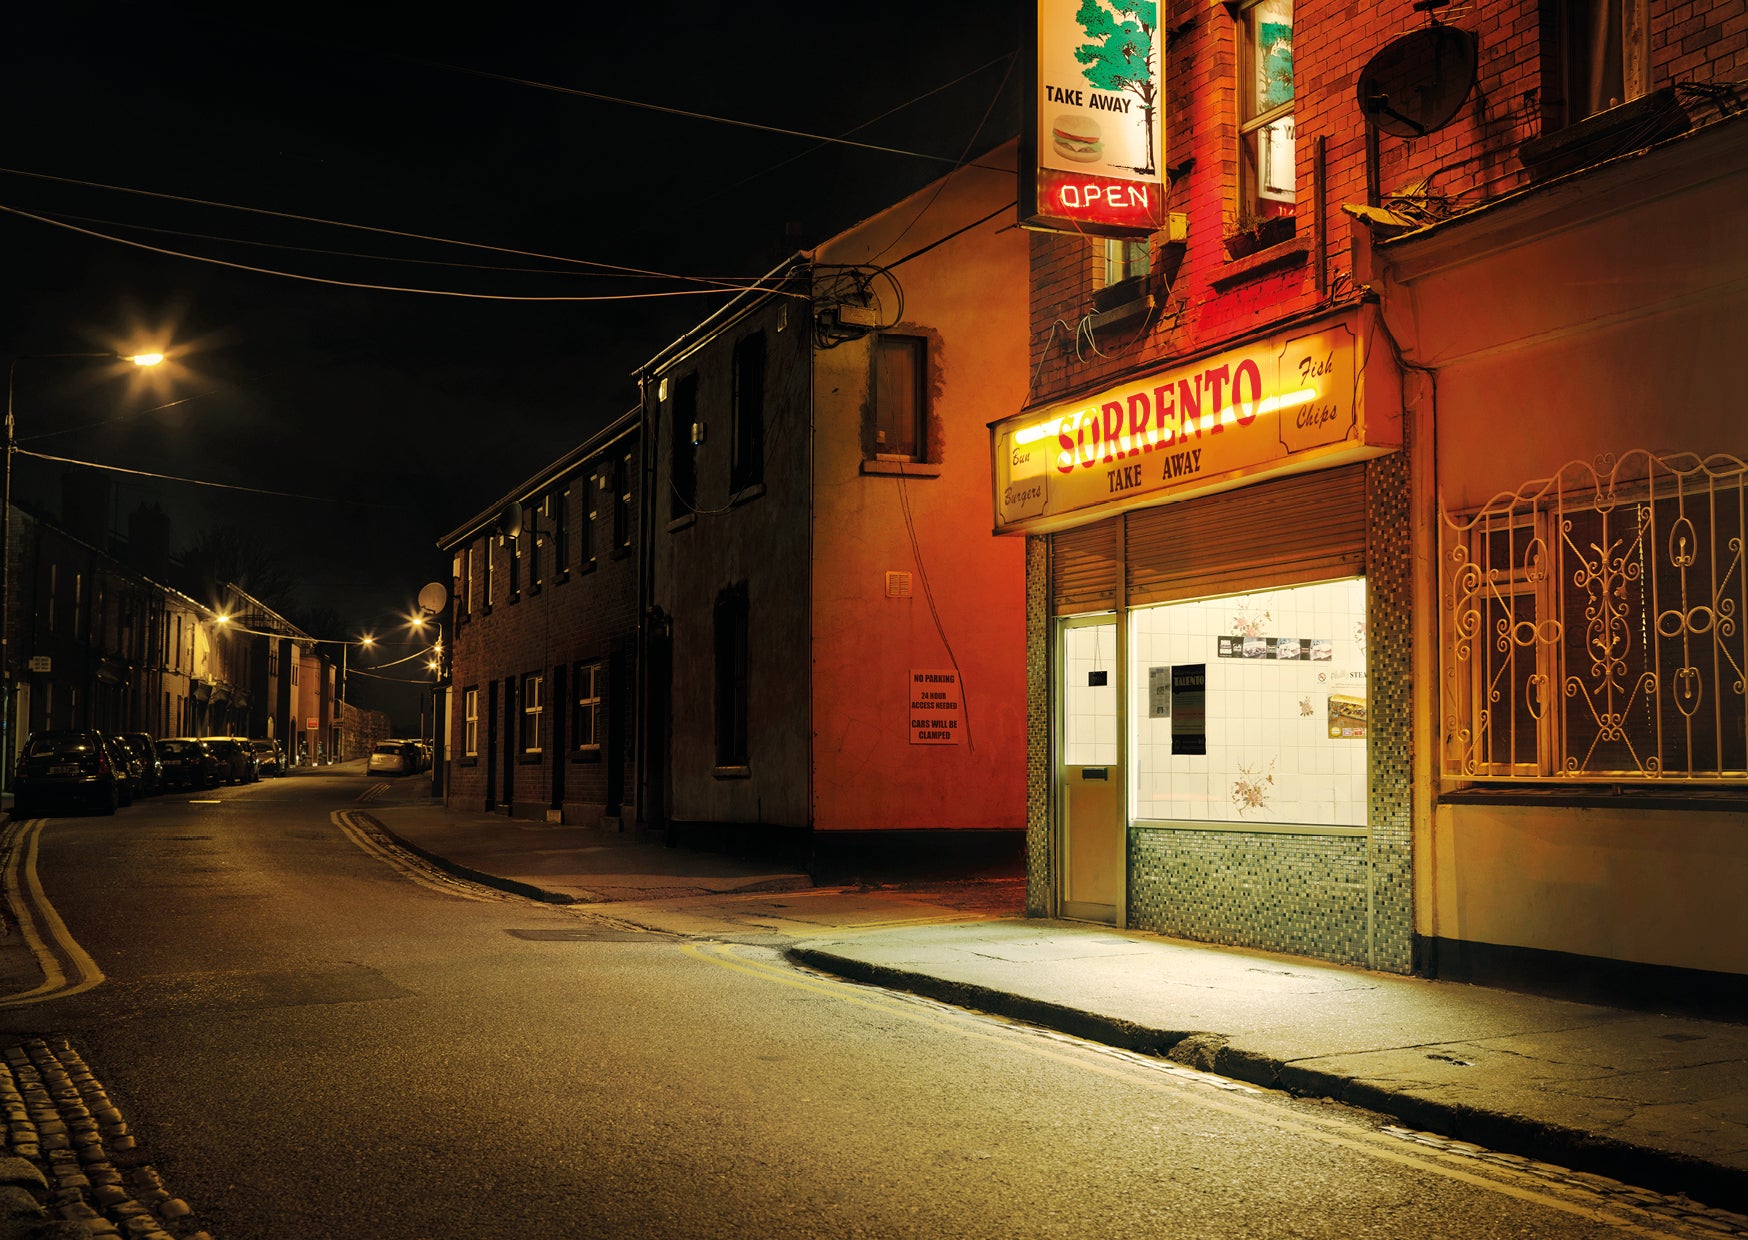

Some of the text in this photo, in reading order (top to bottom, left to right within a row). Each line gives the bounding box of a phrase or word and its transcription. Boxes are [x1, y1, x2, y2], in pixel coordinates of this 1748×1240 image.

[1046, 85, 1132, 114] TAKE AWAY
[1061, 184, 1149, 208] OPEN
[1299, 350, 1334, 386] Fish
[1057, 358, 1262, 474] SORRENTO
[1296, 403, 1337, 430] Chips
[1012, 447, 1031, 466] Bun
[1107, 448, 1202, 493] TAKE AWAY
[1004, 486, 1042, 508] Burgers
[914, 674, 955, 683] NO PARKING
[911, 701, 958, 710] ACCESS NEEDED
[921, 692, 946, 700] 24 HOUR
[911, 719, 958, 729] CARS WILL BE
[918, 731, 951, 740] CLAMPED
